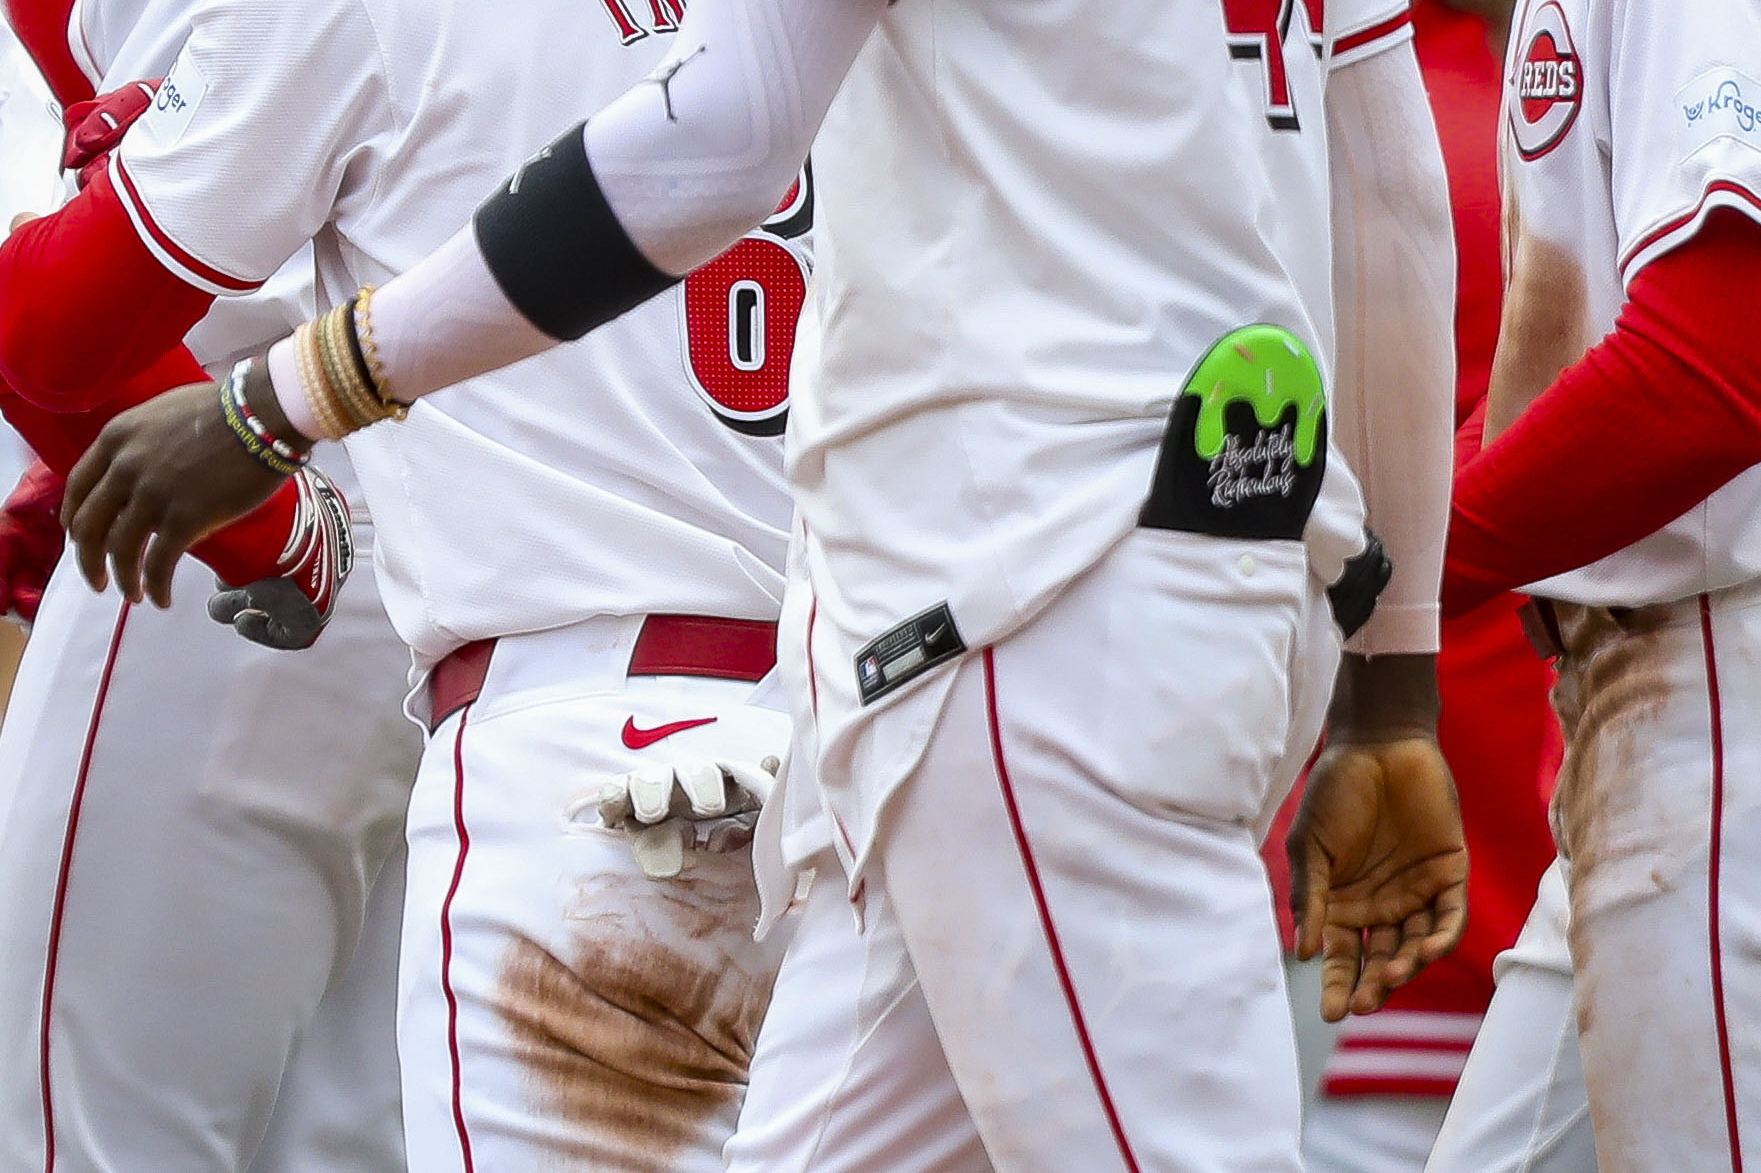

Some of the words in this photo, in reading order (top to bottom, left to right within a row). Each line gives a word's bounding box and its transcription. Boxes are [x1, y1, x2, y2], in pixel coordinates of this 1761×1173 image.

[1520, 60, 1578, 99] REDS
[1208, 423, 1294, 475] Absolutely
[1206, 466, 1297, 508] Ridiculous
